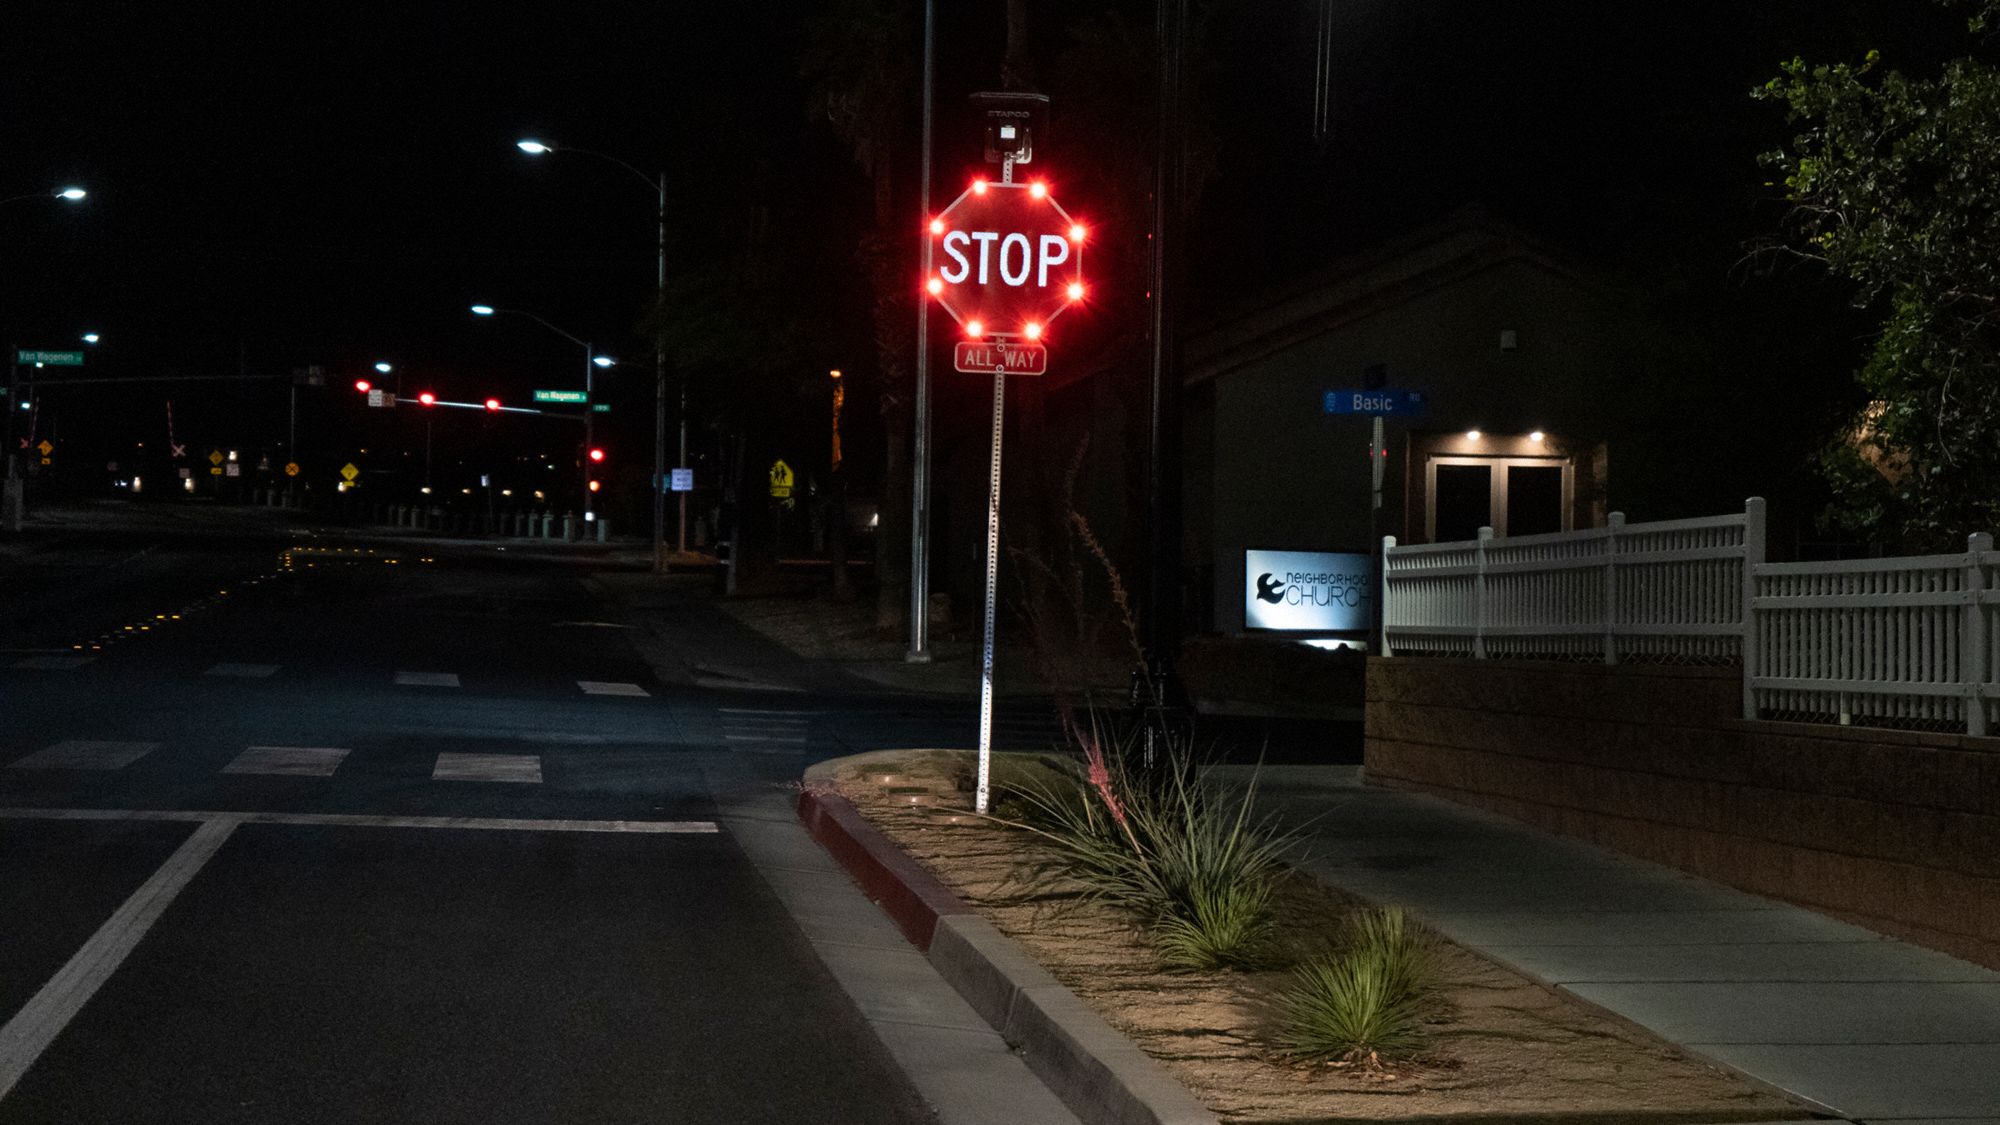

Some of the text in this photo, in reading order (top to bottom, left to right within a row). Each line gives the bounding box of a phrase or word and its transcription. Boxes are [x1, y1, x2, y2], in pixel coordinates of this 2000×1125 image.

[940, 230, 1069, 287] STOP
[19, 351, 35, 361] Van
[964, 350, 1037, 368] ALL WAY
[536, 391, 549, 399] Van
[1353, 393, 1393, 411] Basic
[1286, 585, 1371, 607] CHURCH
